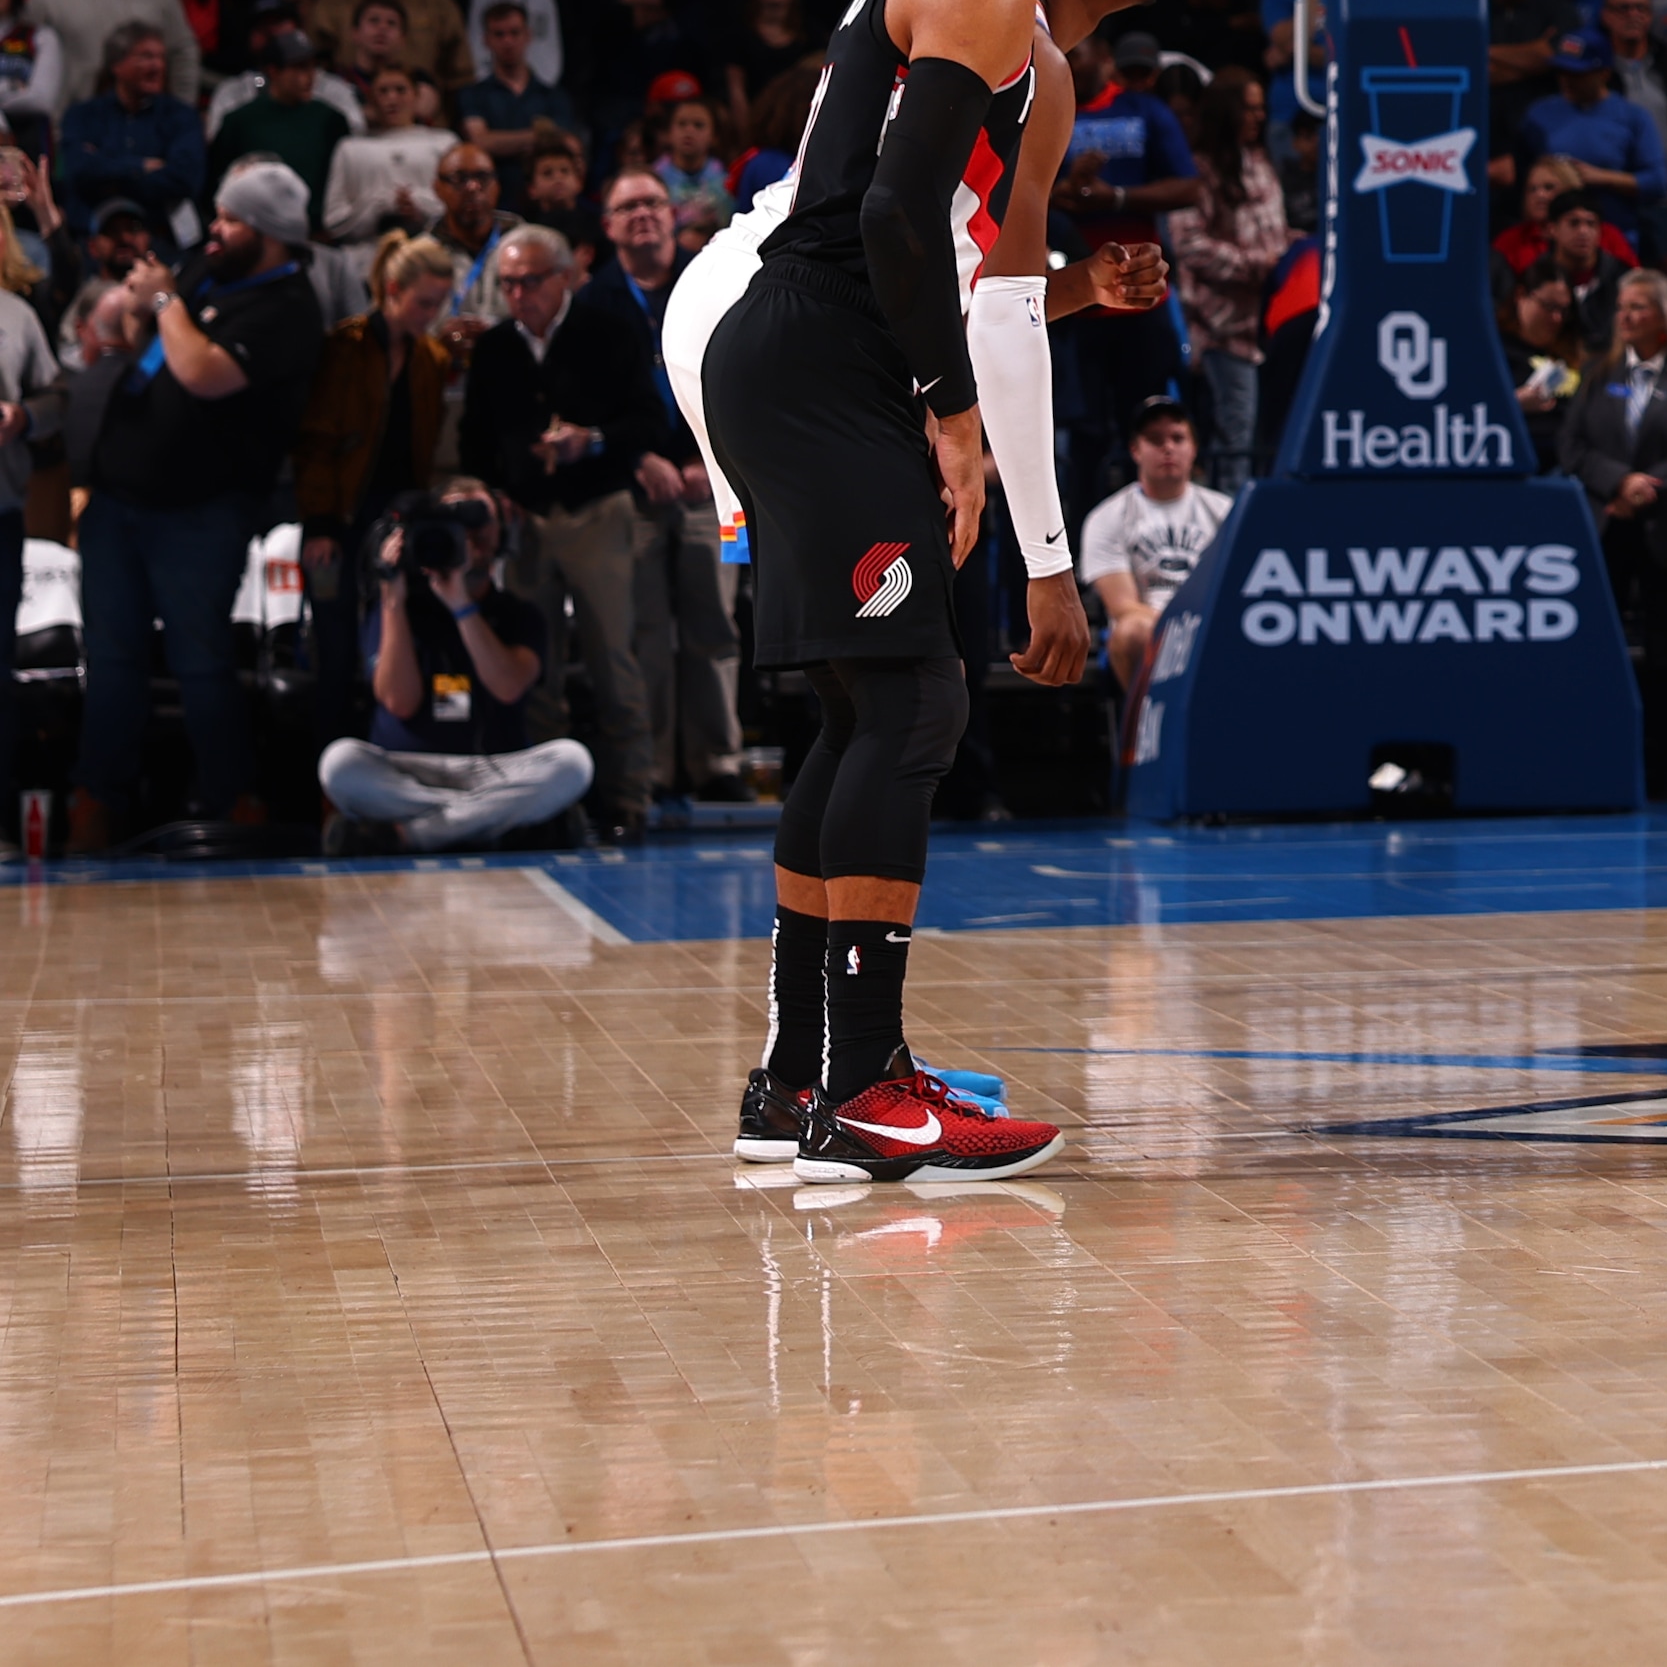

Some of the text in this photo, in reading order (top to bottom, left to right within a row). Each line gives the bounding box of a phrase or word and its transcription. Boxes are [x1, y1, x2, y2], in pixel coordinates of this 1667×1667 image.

[1372, 148, 1459, 174] SONIC
[1321, 402, 1514, 470] Health
[1241, 544, 1581, 598] ALWAYS
[1240, 598, 1580, 647] ONWARD
